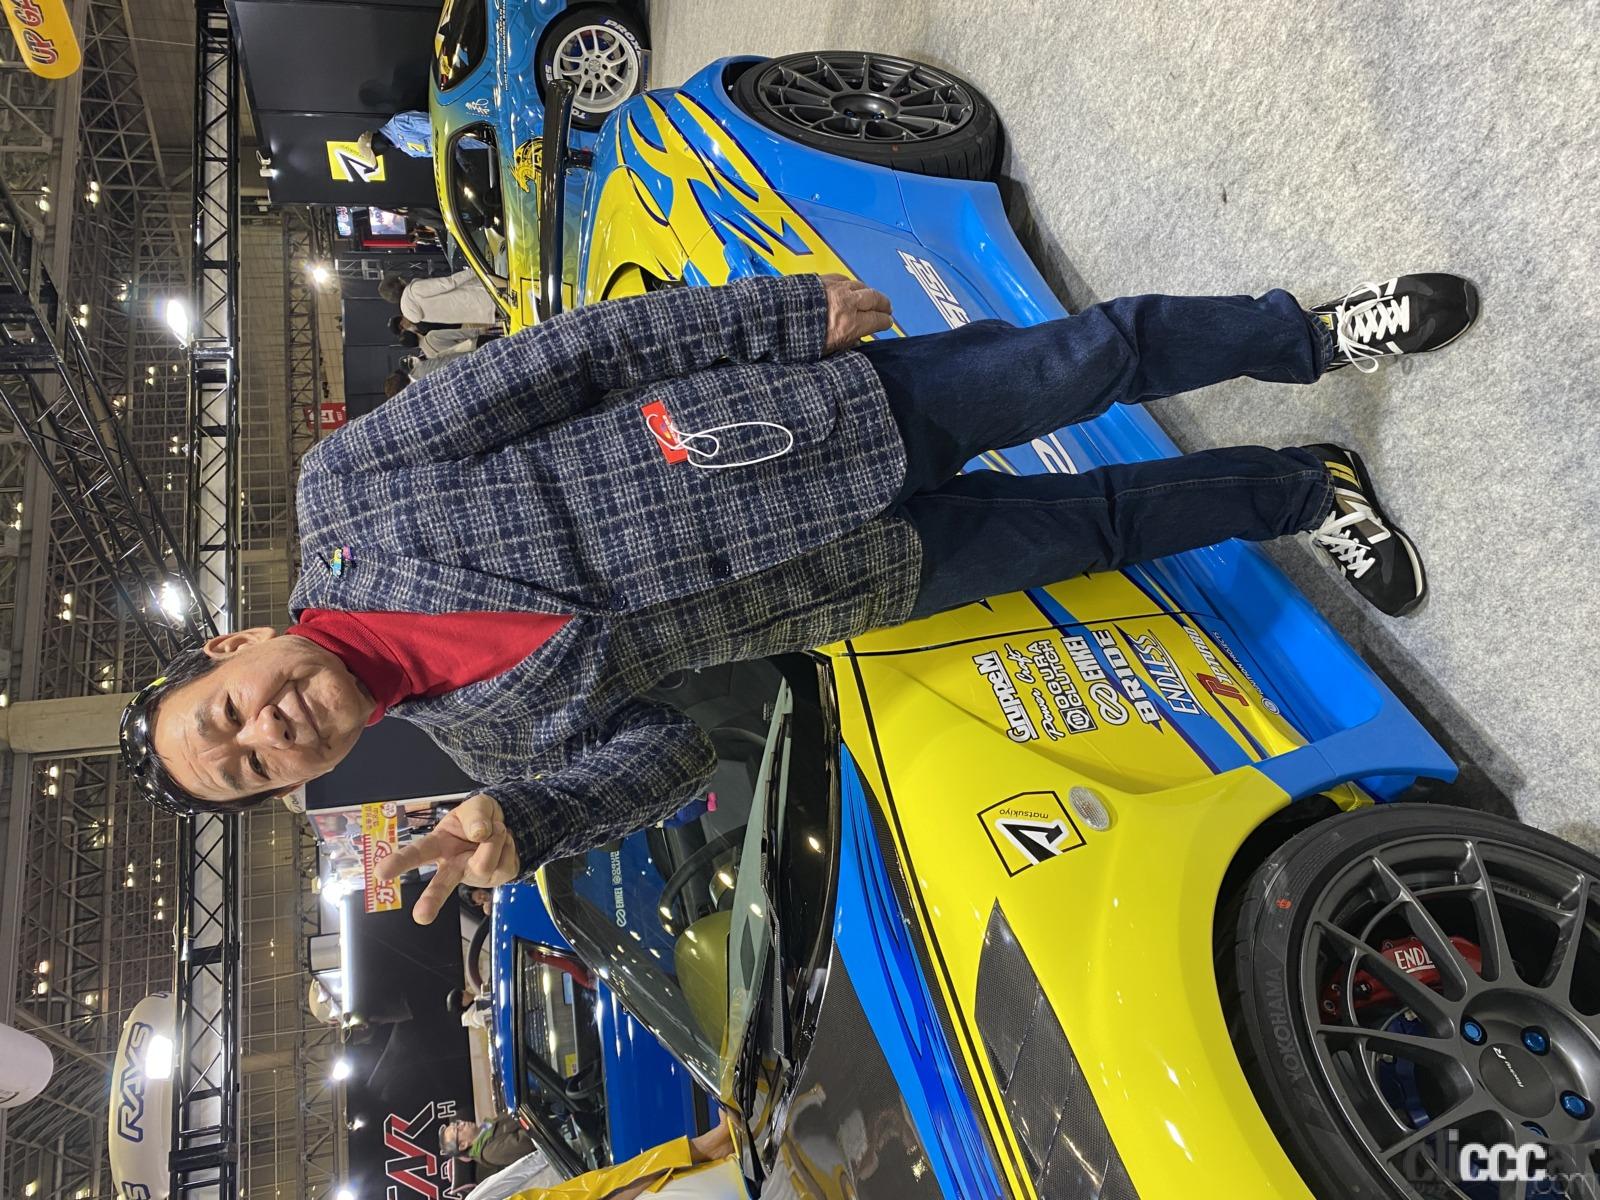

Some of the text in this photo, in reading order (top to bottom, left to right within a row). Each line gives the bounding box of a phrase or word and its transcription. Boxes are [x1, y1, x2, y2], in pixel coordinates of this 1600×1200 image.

[24, 30, 57, 64] UP
[1027, 641, 1070, 709] OGURA
[1037, 639, 1083, 707] CLUTCH
[1060, 635, 1105, 682] ENKEI
[1091, 628, 1161, 724] BRIDE
[1127, 632, 1205, 716] ENDLESS
[1213, 631, 1239, 663] PROJECTS
[972, 651, 1038, 742] GruppeM
[1004, 643, 1066, 741] Power Craft
[999, 807, 1049, 819] matsukiyo
[614, 886, 625, 908] ENKEI
[1265, 967, 1305, 1083] YOKOHAMA
[117, 1021, 154, 1143] RAYS
